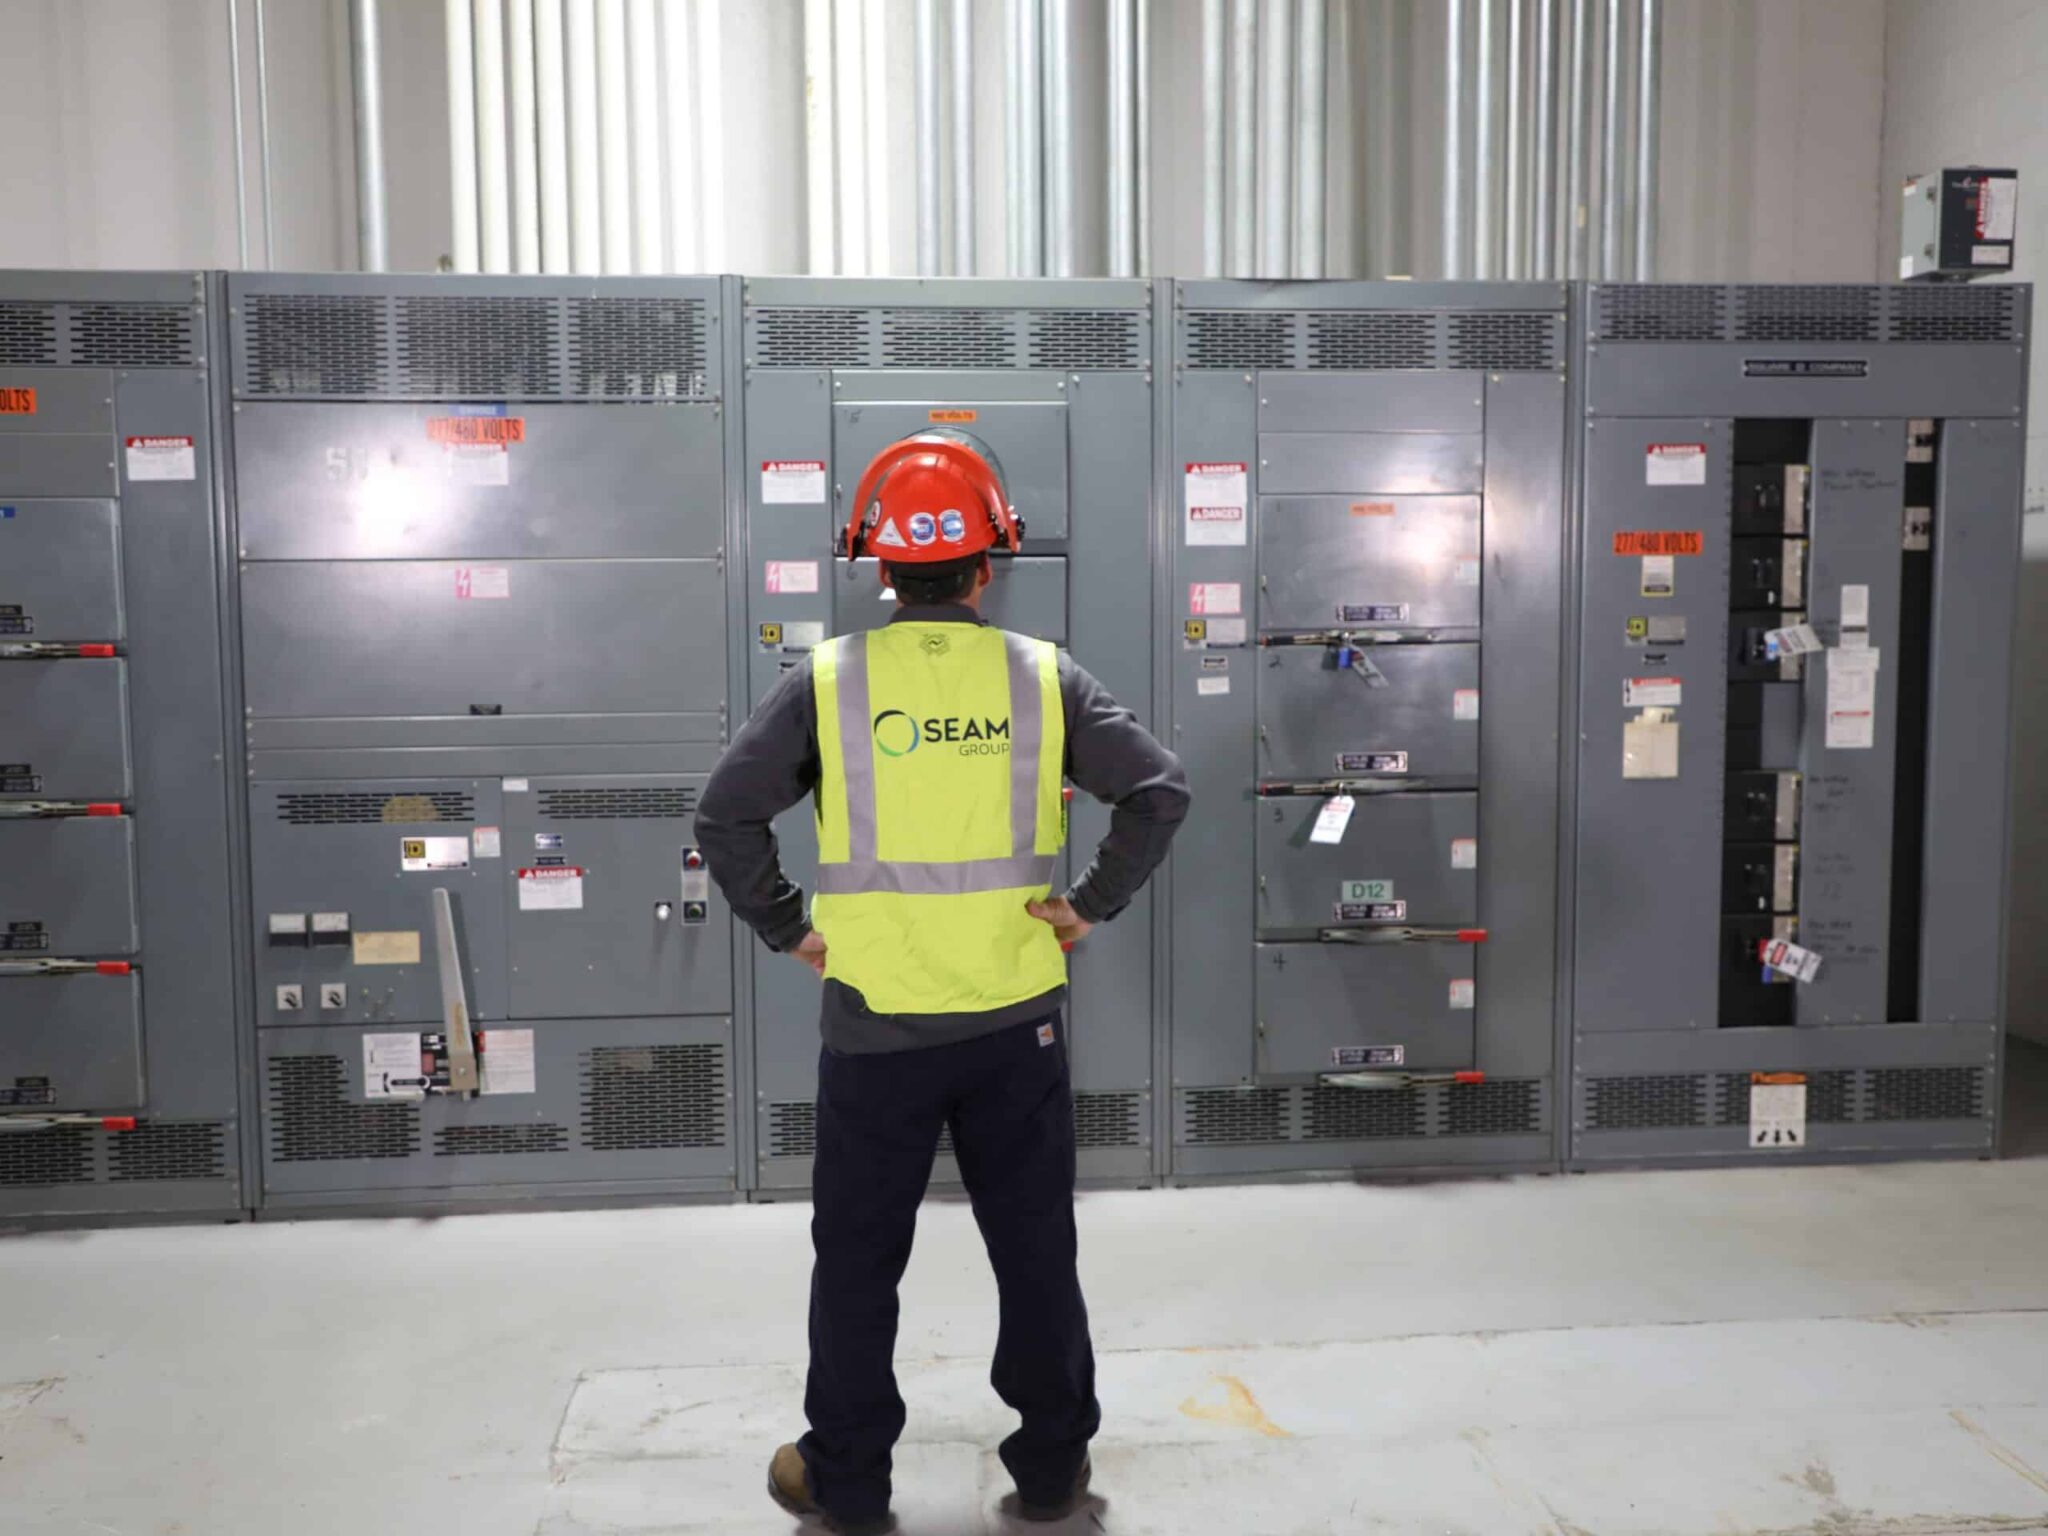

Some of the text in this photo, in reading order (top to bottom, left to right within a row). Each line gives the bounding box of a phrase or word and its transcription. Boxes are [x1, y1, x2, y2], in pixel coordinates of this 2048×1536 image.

[482, 418, 520, 440] VOLTS
[143, 438, 188, 447] DANGER
[1664, 532, 1697, 553] VOLTS
[924, 717, 1009, 743] SEAM
[959, 743, 1010, 756] GROUP
[535, 869, 577, 878] DANGER
[1352, 883, 1384, 899] D12
